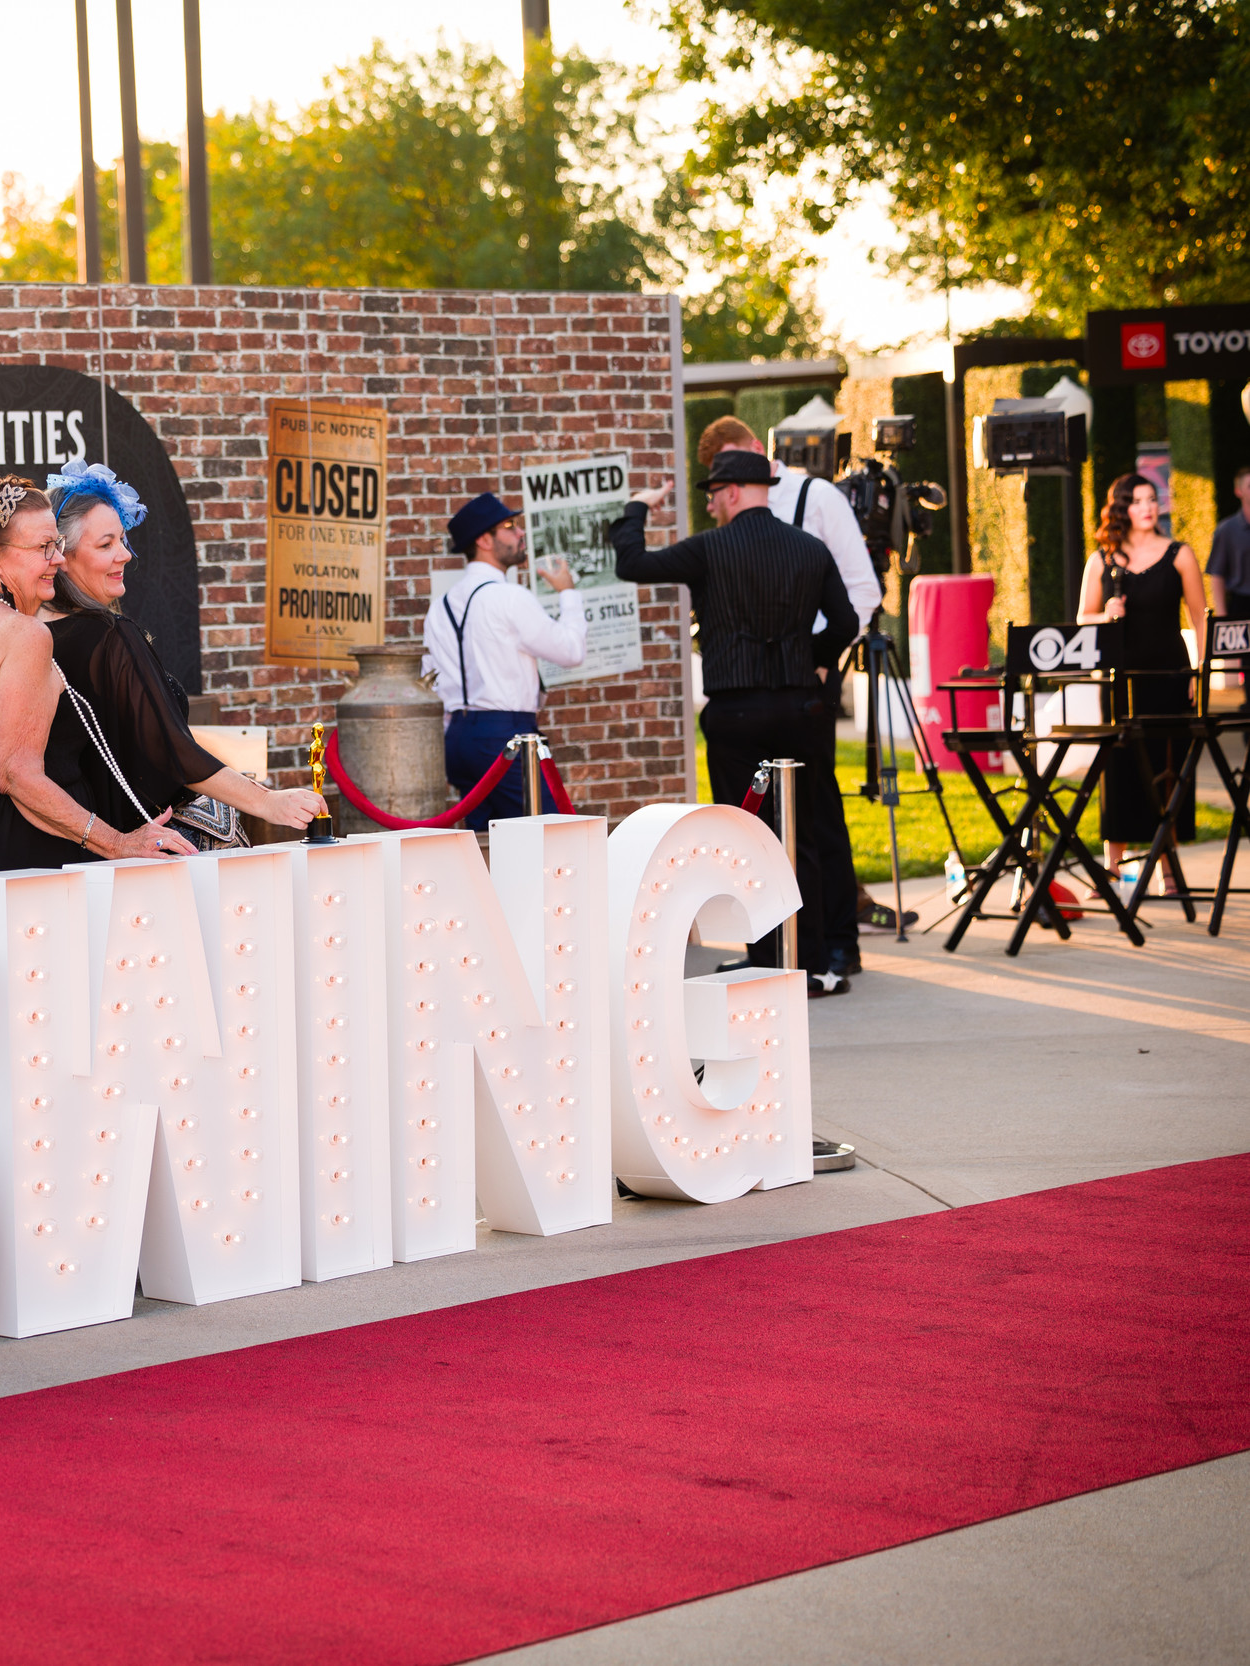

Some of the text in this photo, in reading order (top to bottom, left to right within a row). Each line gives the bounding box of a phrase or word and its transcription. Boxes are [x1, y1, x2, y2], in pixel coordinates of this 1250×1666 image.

[330, 423, 376, 440] NOTICE
[276, 458, 379, 520] CLOSED
[526, 465, 624, 502] WANTED
[278, 524, 376, 547] FOR ONE YEAR
[293, 563, 360, 580] VIOLATION
[279, 587, 372, 624] PROHIBITION
[599, 602, 635, 621] STILLS
[305, 623, 347, 636] LAW
[1217, 625, 1248, 650] FOX
